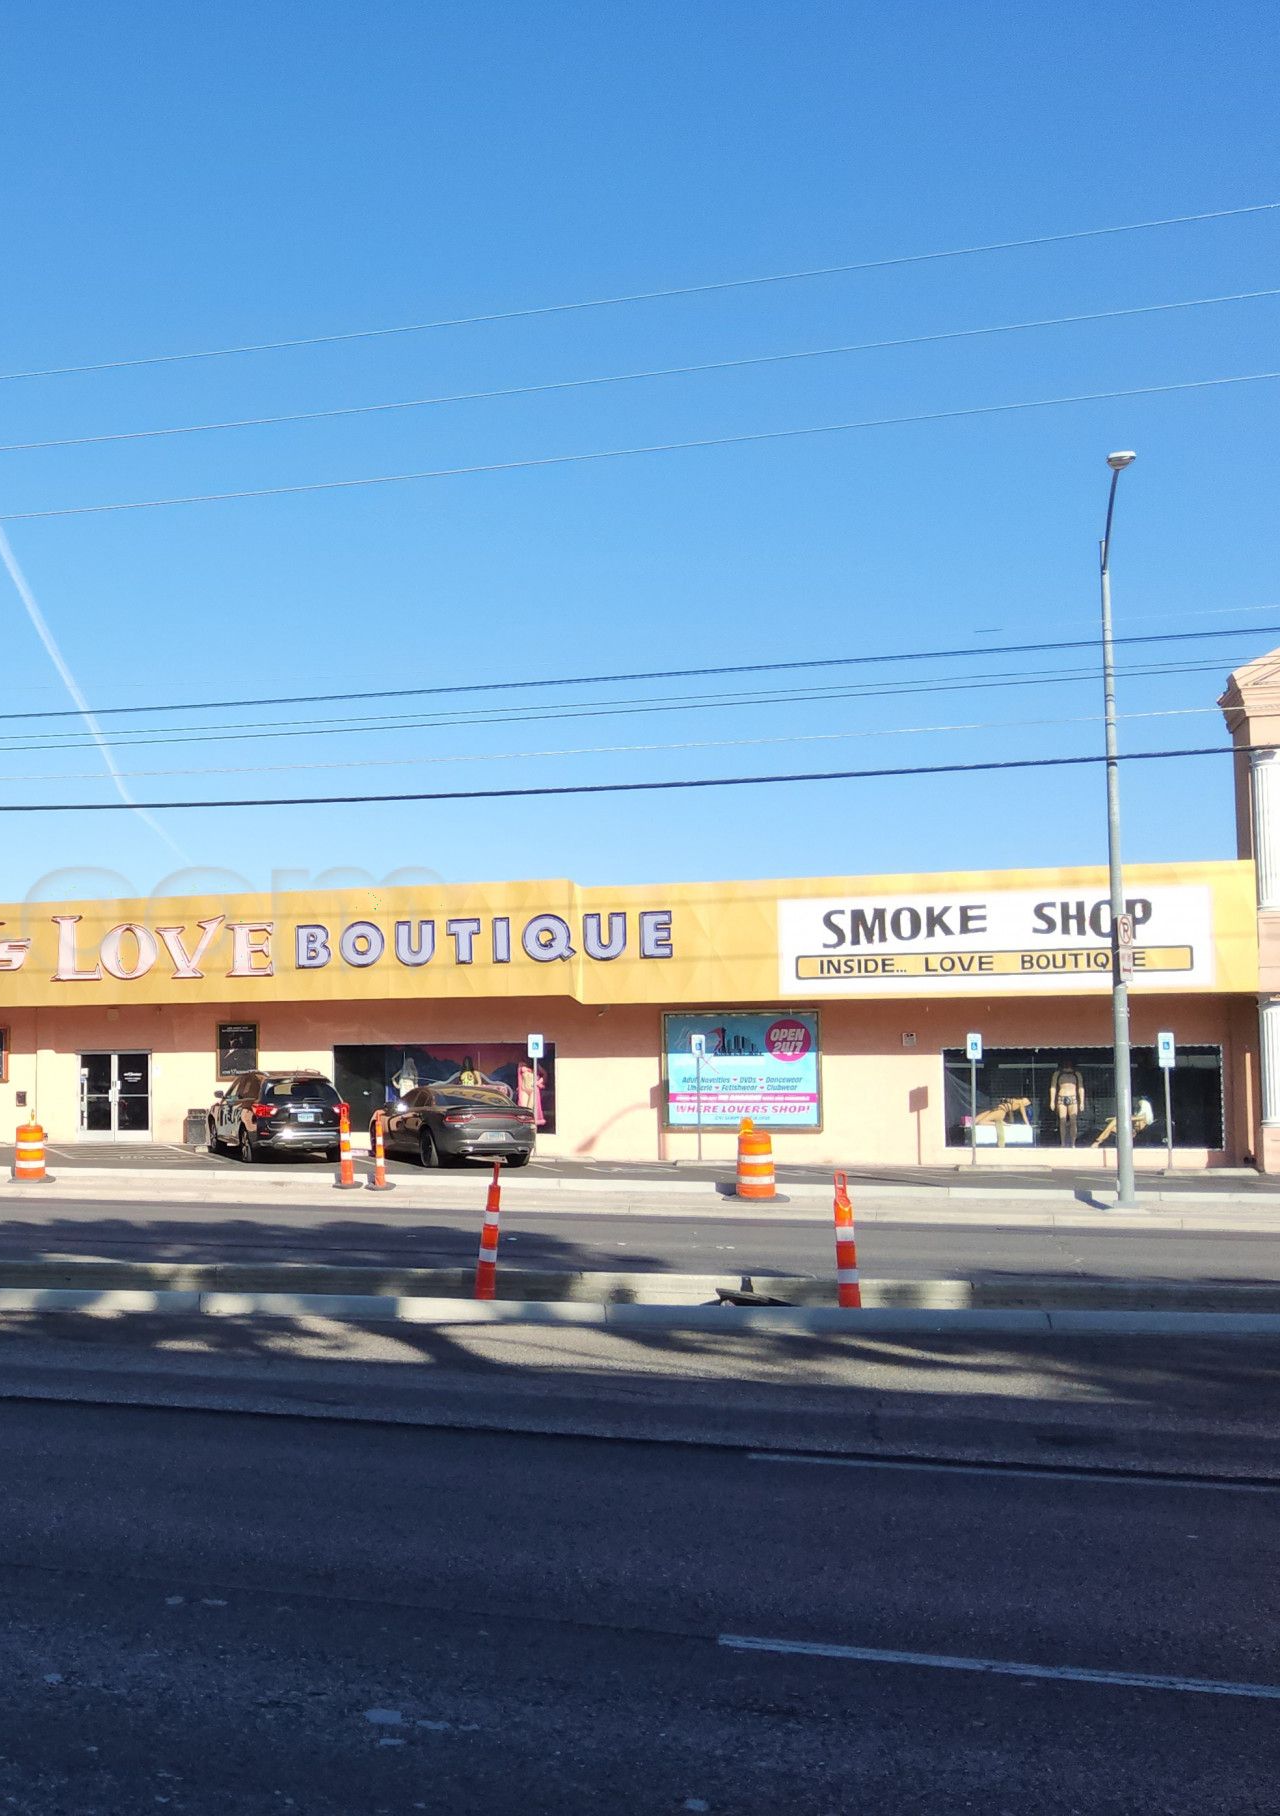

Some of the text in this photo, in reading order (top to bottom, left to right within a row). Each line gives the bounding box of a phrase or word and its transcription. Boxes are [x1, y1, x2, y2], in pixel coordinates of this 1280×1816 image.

[822, 898, 1152, 949] SMOKE SHOP
[50, 914, 275, 982] LOVE
[295, 910, 673, 969] BOUTIQUE
[819, 956, 907, 975] INSIDE...
[924, 955, 994, 973] LOVE
[1021, 950, 1146, 971] BOUTIQE
[770, 1028, 806, 1042] OPEN
[773, 1041, 803, 1056] 24/7
[687, 1084, 713, 1092] Linerie
[676, 1104, 811, 1114] WHERE LOVERS SHOP!
